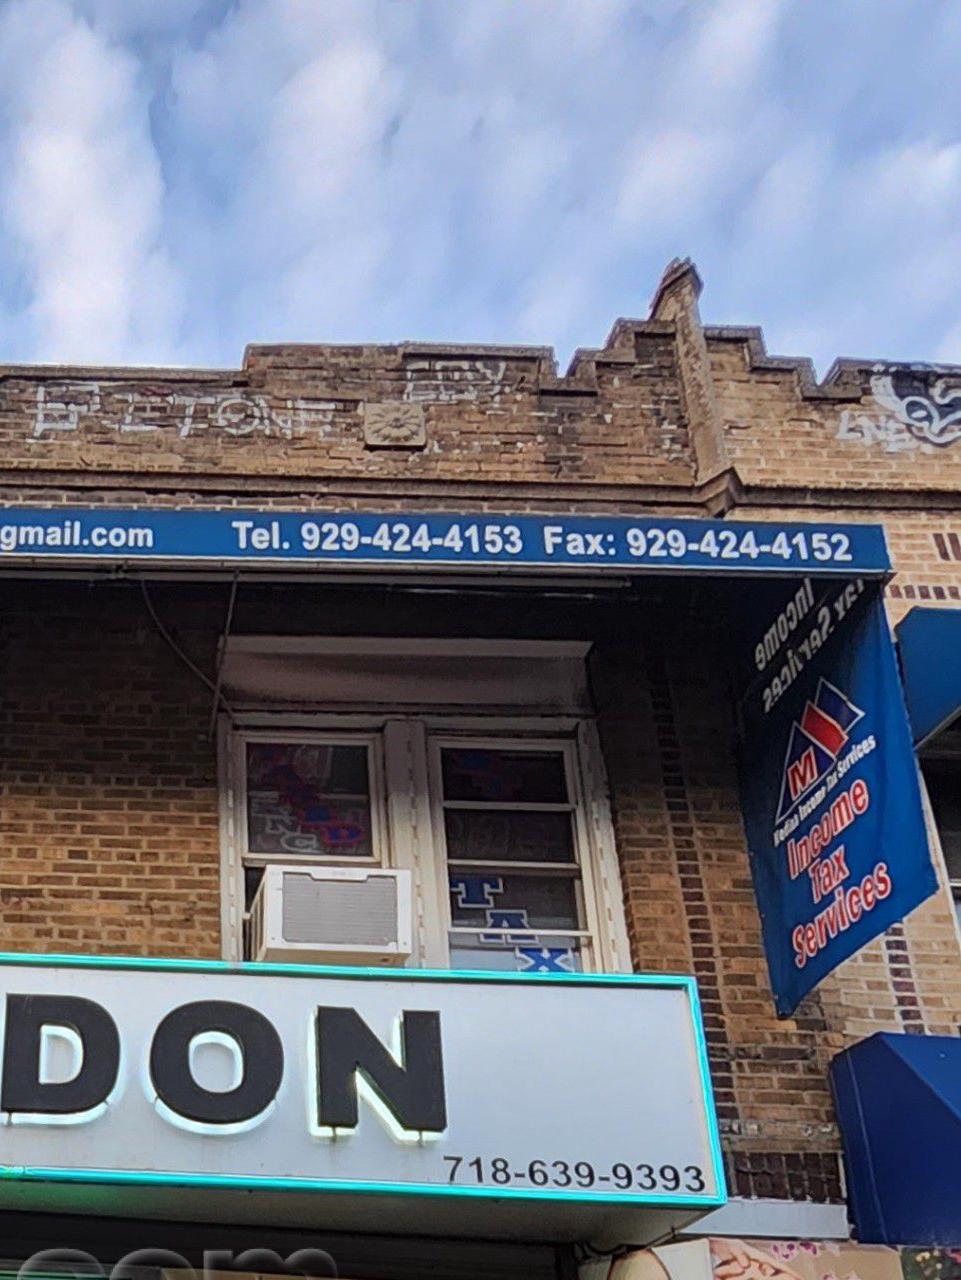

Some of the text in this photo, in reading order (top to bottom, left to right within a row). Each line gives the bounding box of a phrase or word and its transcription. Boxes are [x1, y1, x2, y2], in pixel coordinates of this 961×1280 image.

[233, 521, 289, 549] Tel.
[301, 522, 523, 554] 929-424-4153
[544, 525, 616, 556] Fax:
[627, 527, 853, 562] 929-424-4152
[787, 778, 869, 880] Income
[809, 844, 849, 904] Tax
[792, 862, 891, 968] Services
[443, 1155, 706, 1192] 718-639-9393
